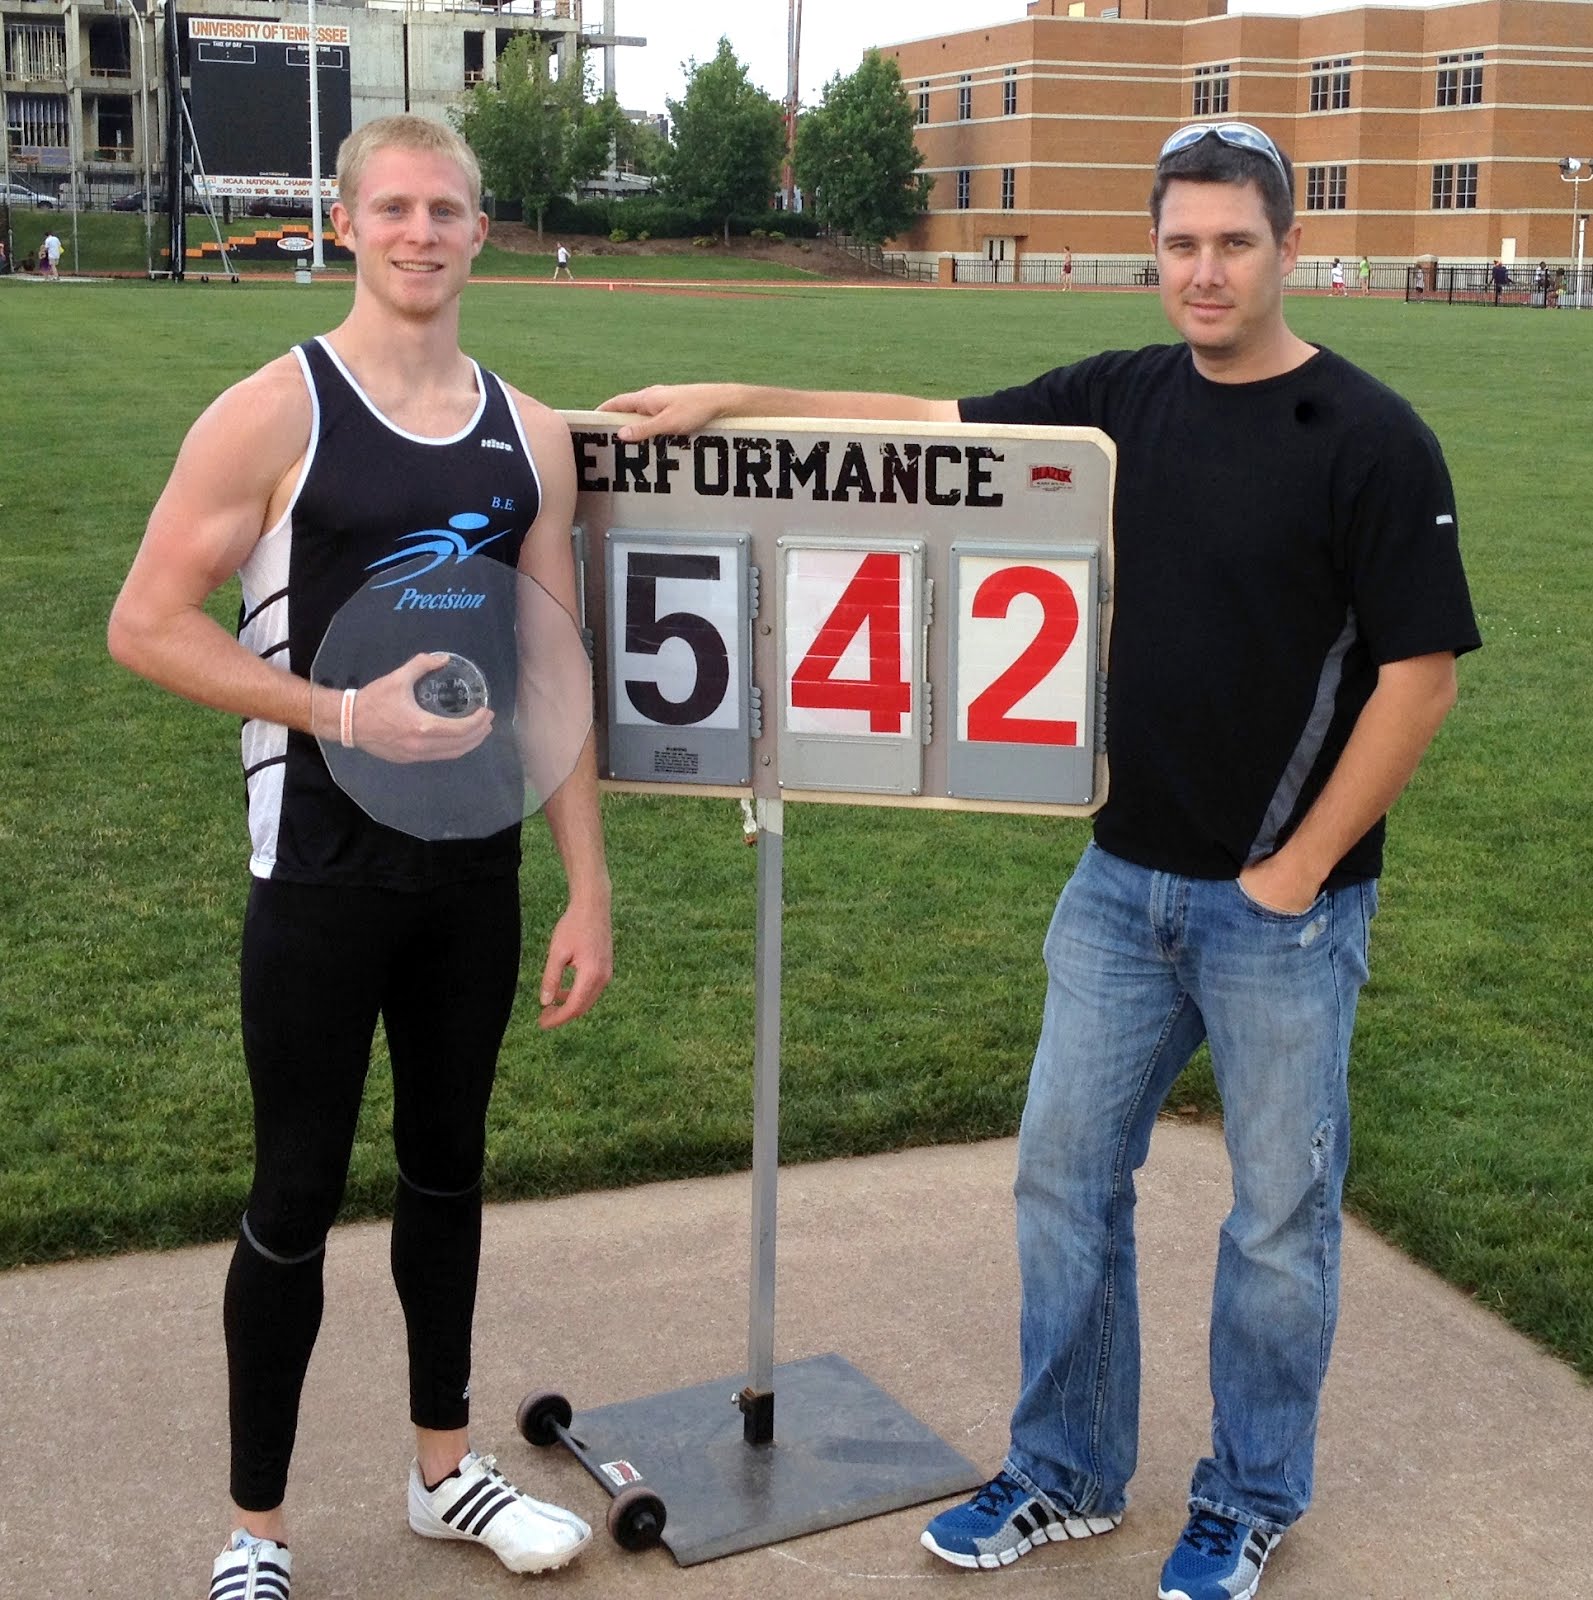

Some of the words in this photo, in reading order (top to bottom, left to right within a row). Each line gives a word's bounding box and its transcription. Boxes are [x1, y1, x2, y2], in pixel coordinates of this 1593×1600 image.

[191, 21, 260, 39] UNIVERSITY
[262, 24, 279, 40] OF
[279, 25, 347, 43] TENNSSEE
[246, 178, 281, 186] NATIONAL
[571, 432, 1005, 507] ERFORMANCE
[491, 496, 515, 511] B.E.
[393, 588, 486, 611] Precision
[625, 551, 730, 726] 5
[791, 553, 911, 733] 4
[967, 566, 1079, 747] 2
